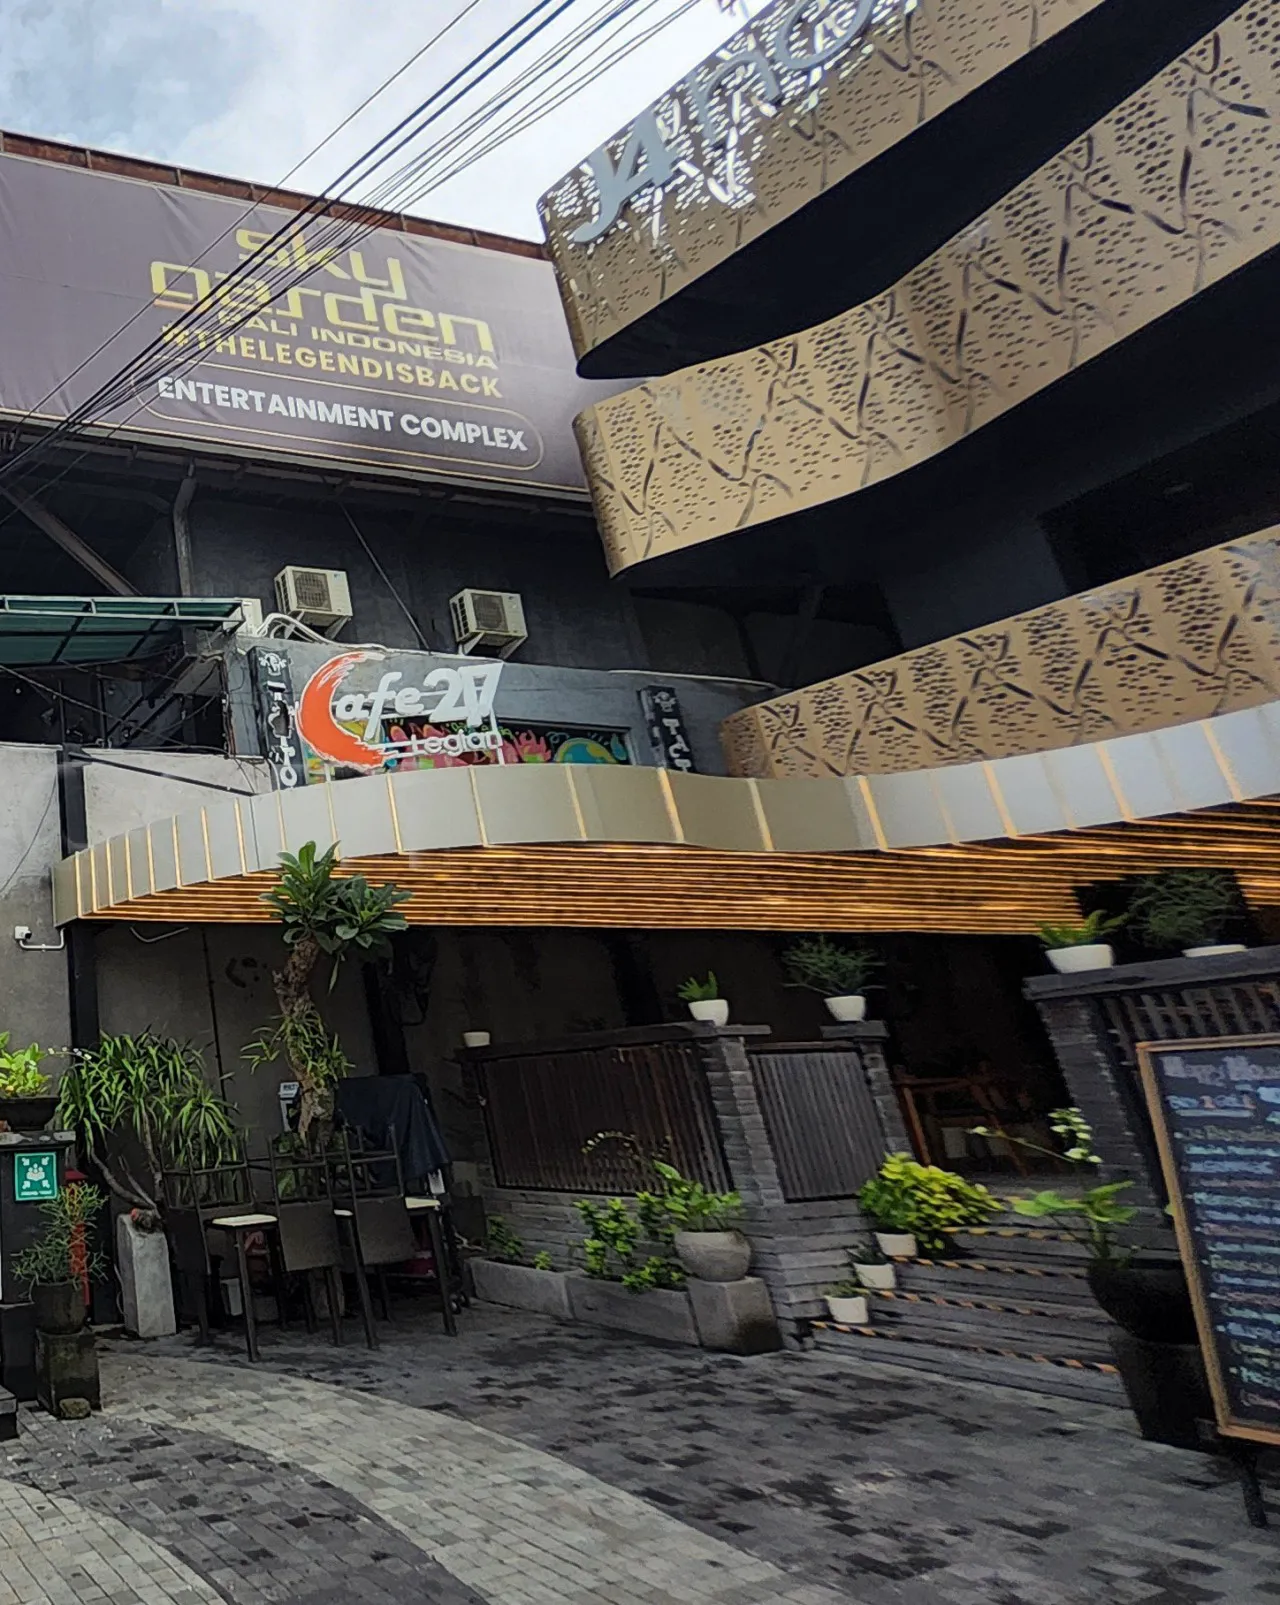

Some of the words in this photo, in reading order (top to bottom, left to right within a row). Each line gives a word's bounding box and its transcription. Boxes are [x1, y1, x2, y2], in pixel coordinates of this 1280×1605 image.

[235, 223, 408, 300] sky
[150, 260, 495, 352] garden
[219, 309, 298, 336] BALI
[311, 326, 499, 369] INDONESIA
[161, 320, 504, 398] #THELEGENDISBACK
[157, 376, 394, 432] ENTERTAINMENT
[400, 413, 528, 452] COMPLEX
[422, 661, 505, 727] 27
